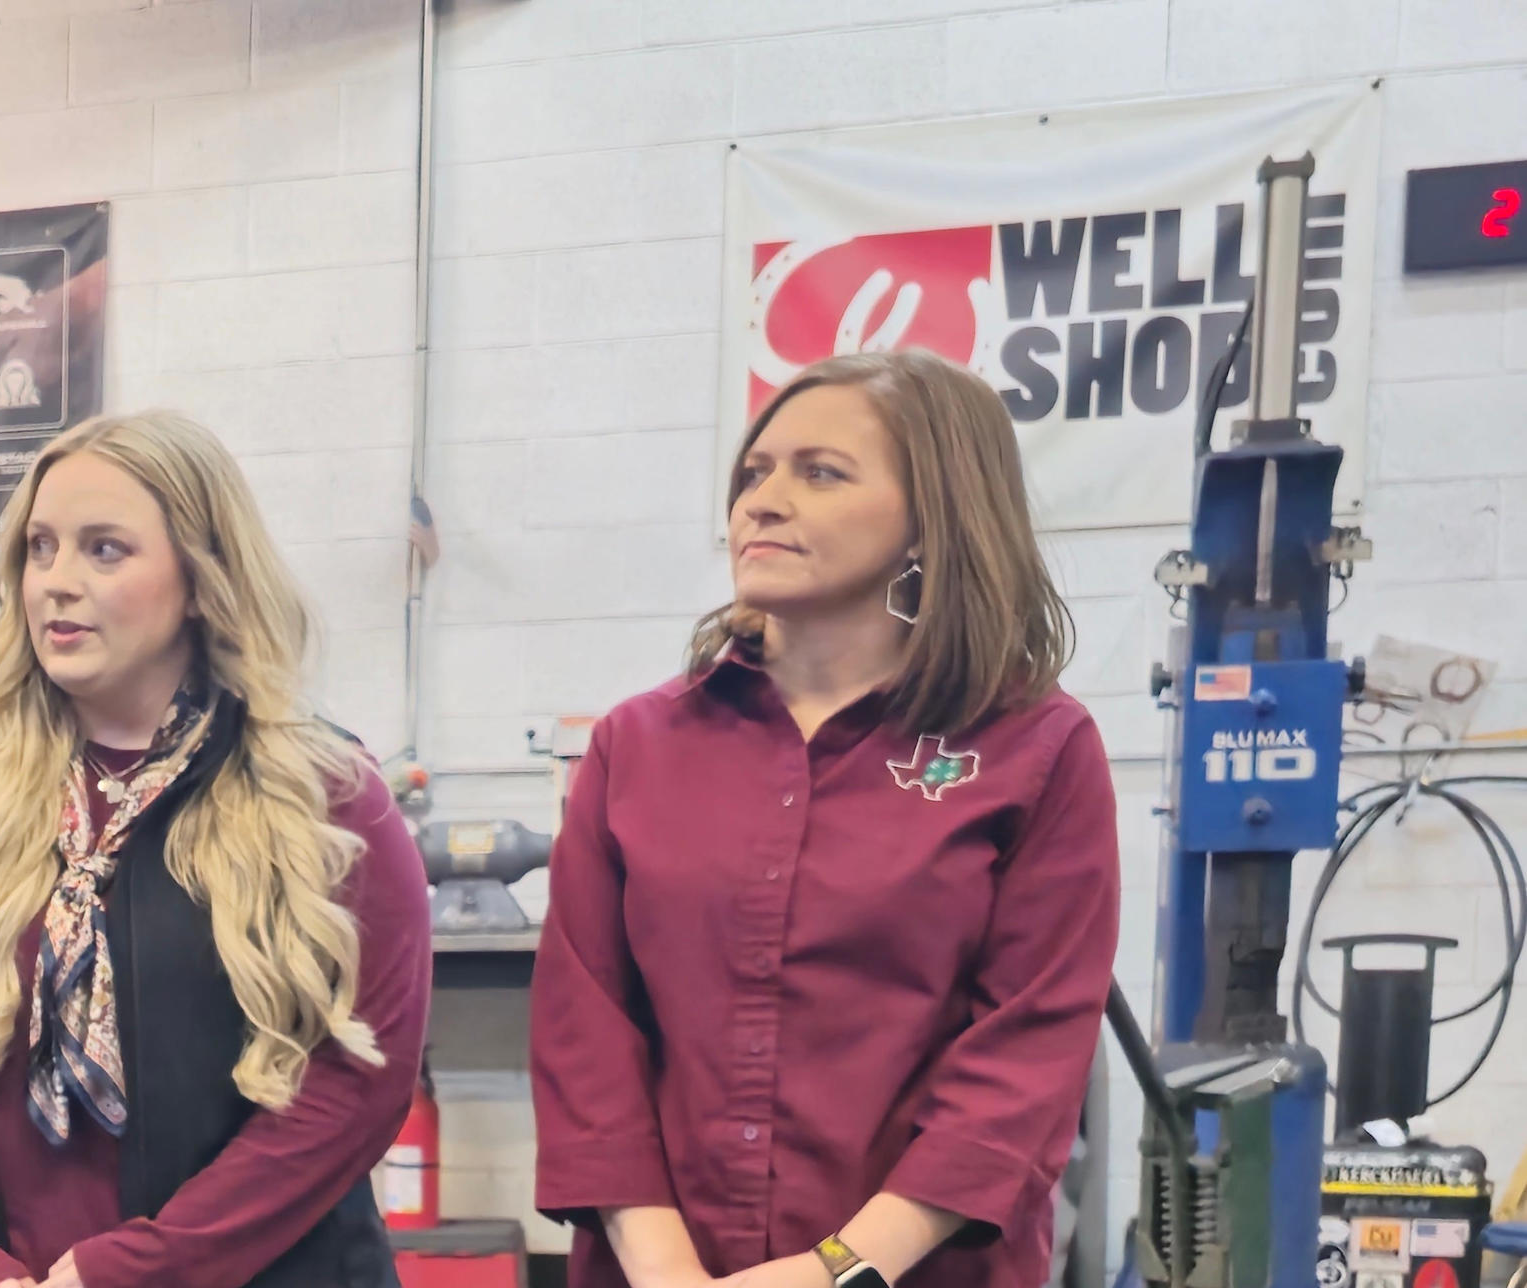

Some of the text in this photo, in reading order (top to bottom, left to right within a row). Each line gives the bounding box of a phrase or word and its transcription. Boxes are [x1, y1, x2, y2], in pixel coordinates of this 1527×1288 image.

[1482, 187, 1521, 238] 2
[998, 202, 1256, 320] WELL
[1202, 747, 1317, 782] 110
